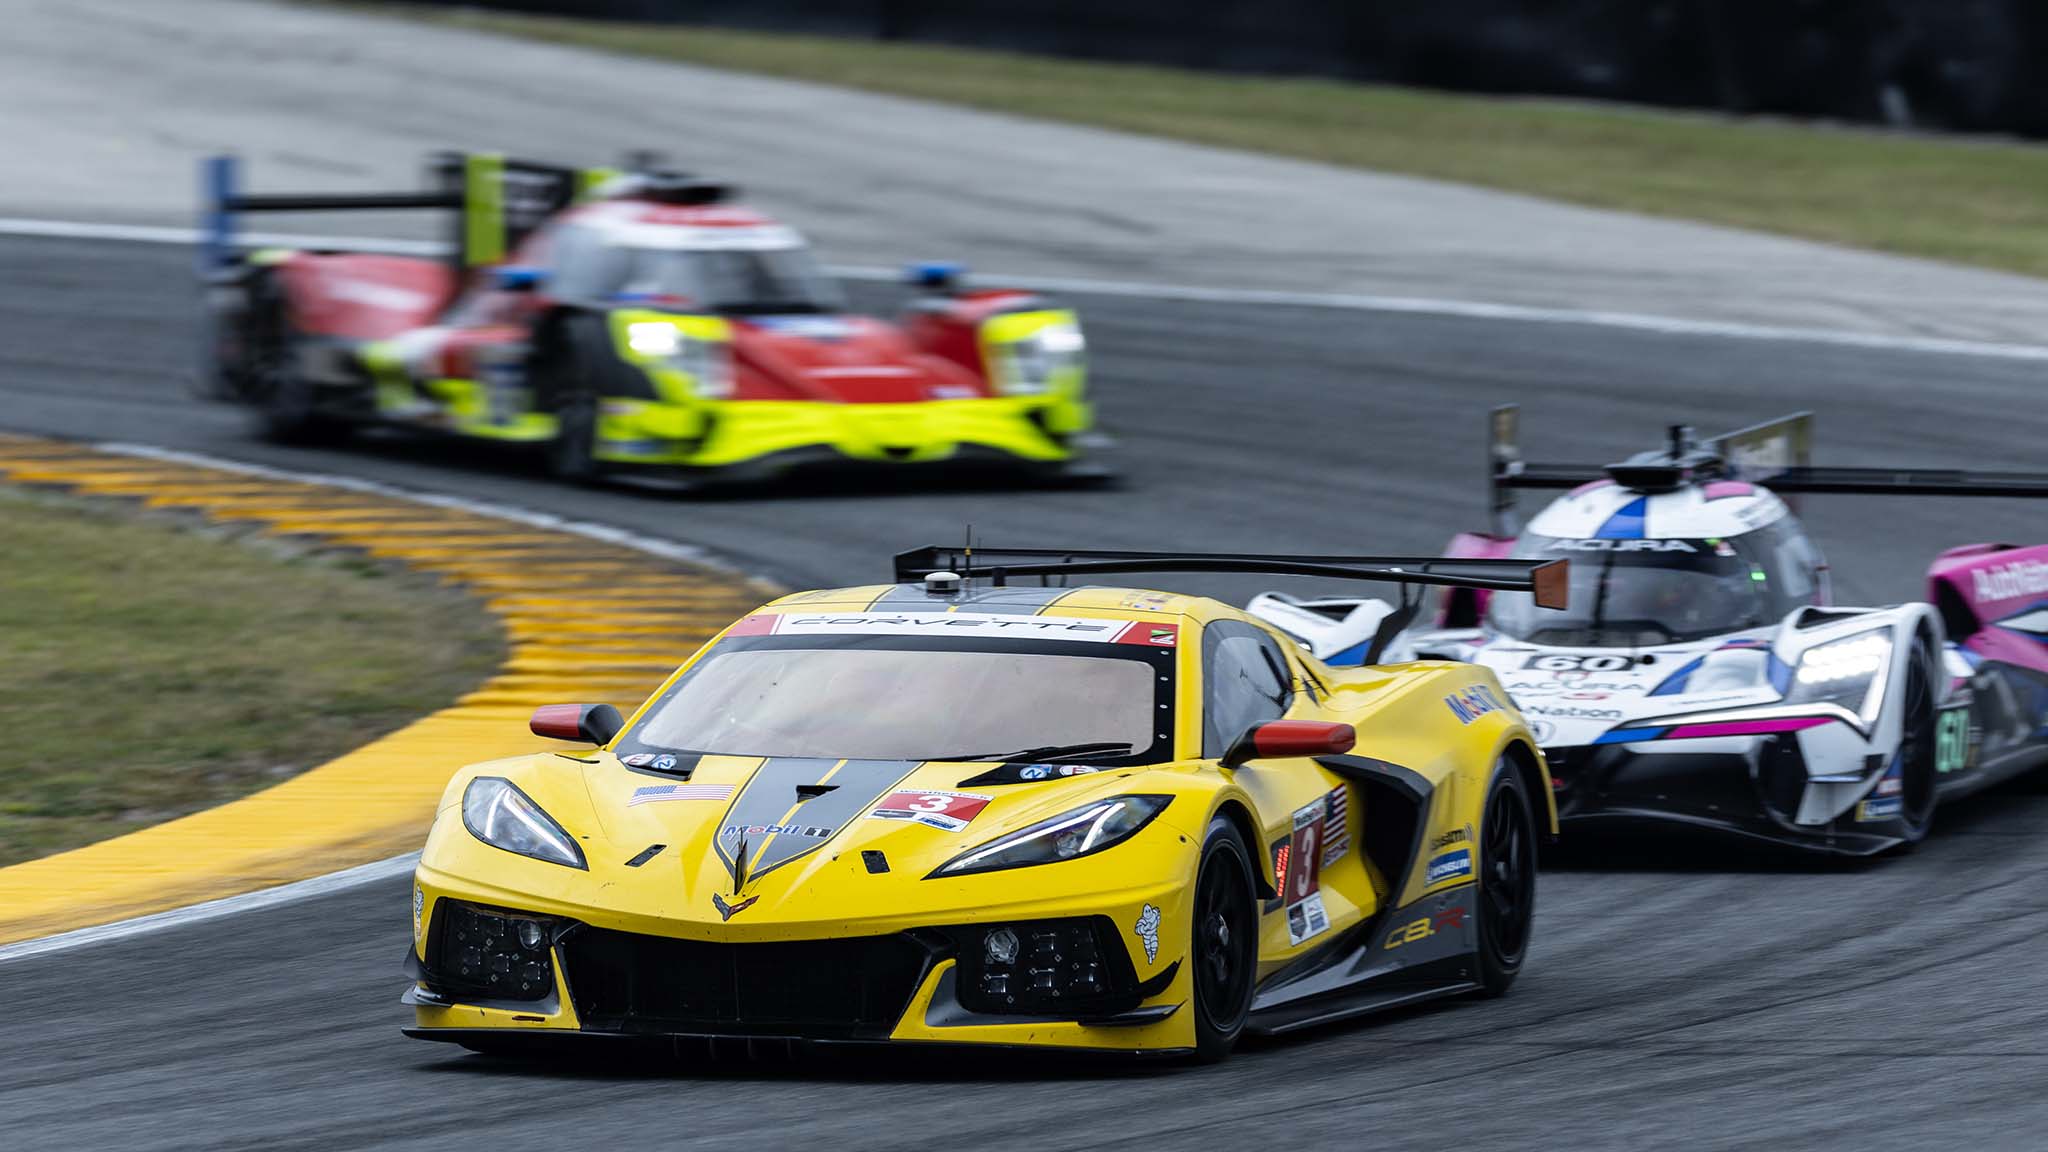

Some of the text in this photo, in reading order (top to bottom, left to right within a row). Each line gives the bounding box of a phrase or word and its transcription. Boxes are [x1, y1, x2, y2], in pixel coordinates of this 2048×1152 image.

[1549, 539, 1698, 552] ACURA
[791, 617, 1109, 632] CORVETTE
[1534, 655, 1629, 671] 60
[1509, 681, 1646, 690] ACURA
[1524, 705, 1622, 718] Nation
[908, 795, 955, 813] 3
[723, 824, 801, 836] Mobil
[1297, 826, 1315, 897] 3
[1384, 907, 1467, 949] C8.R
